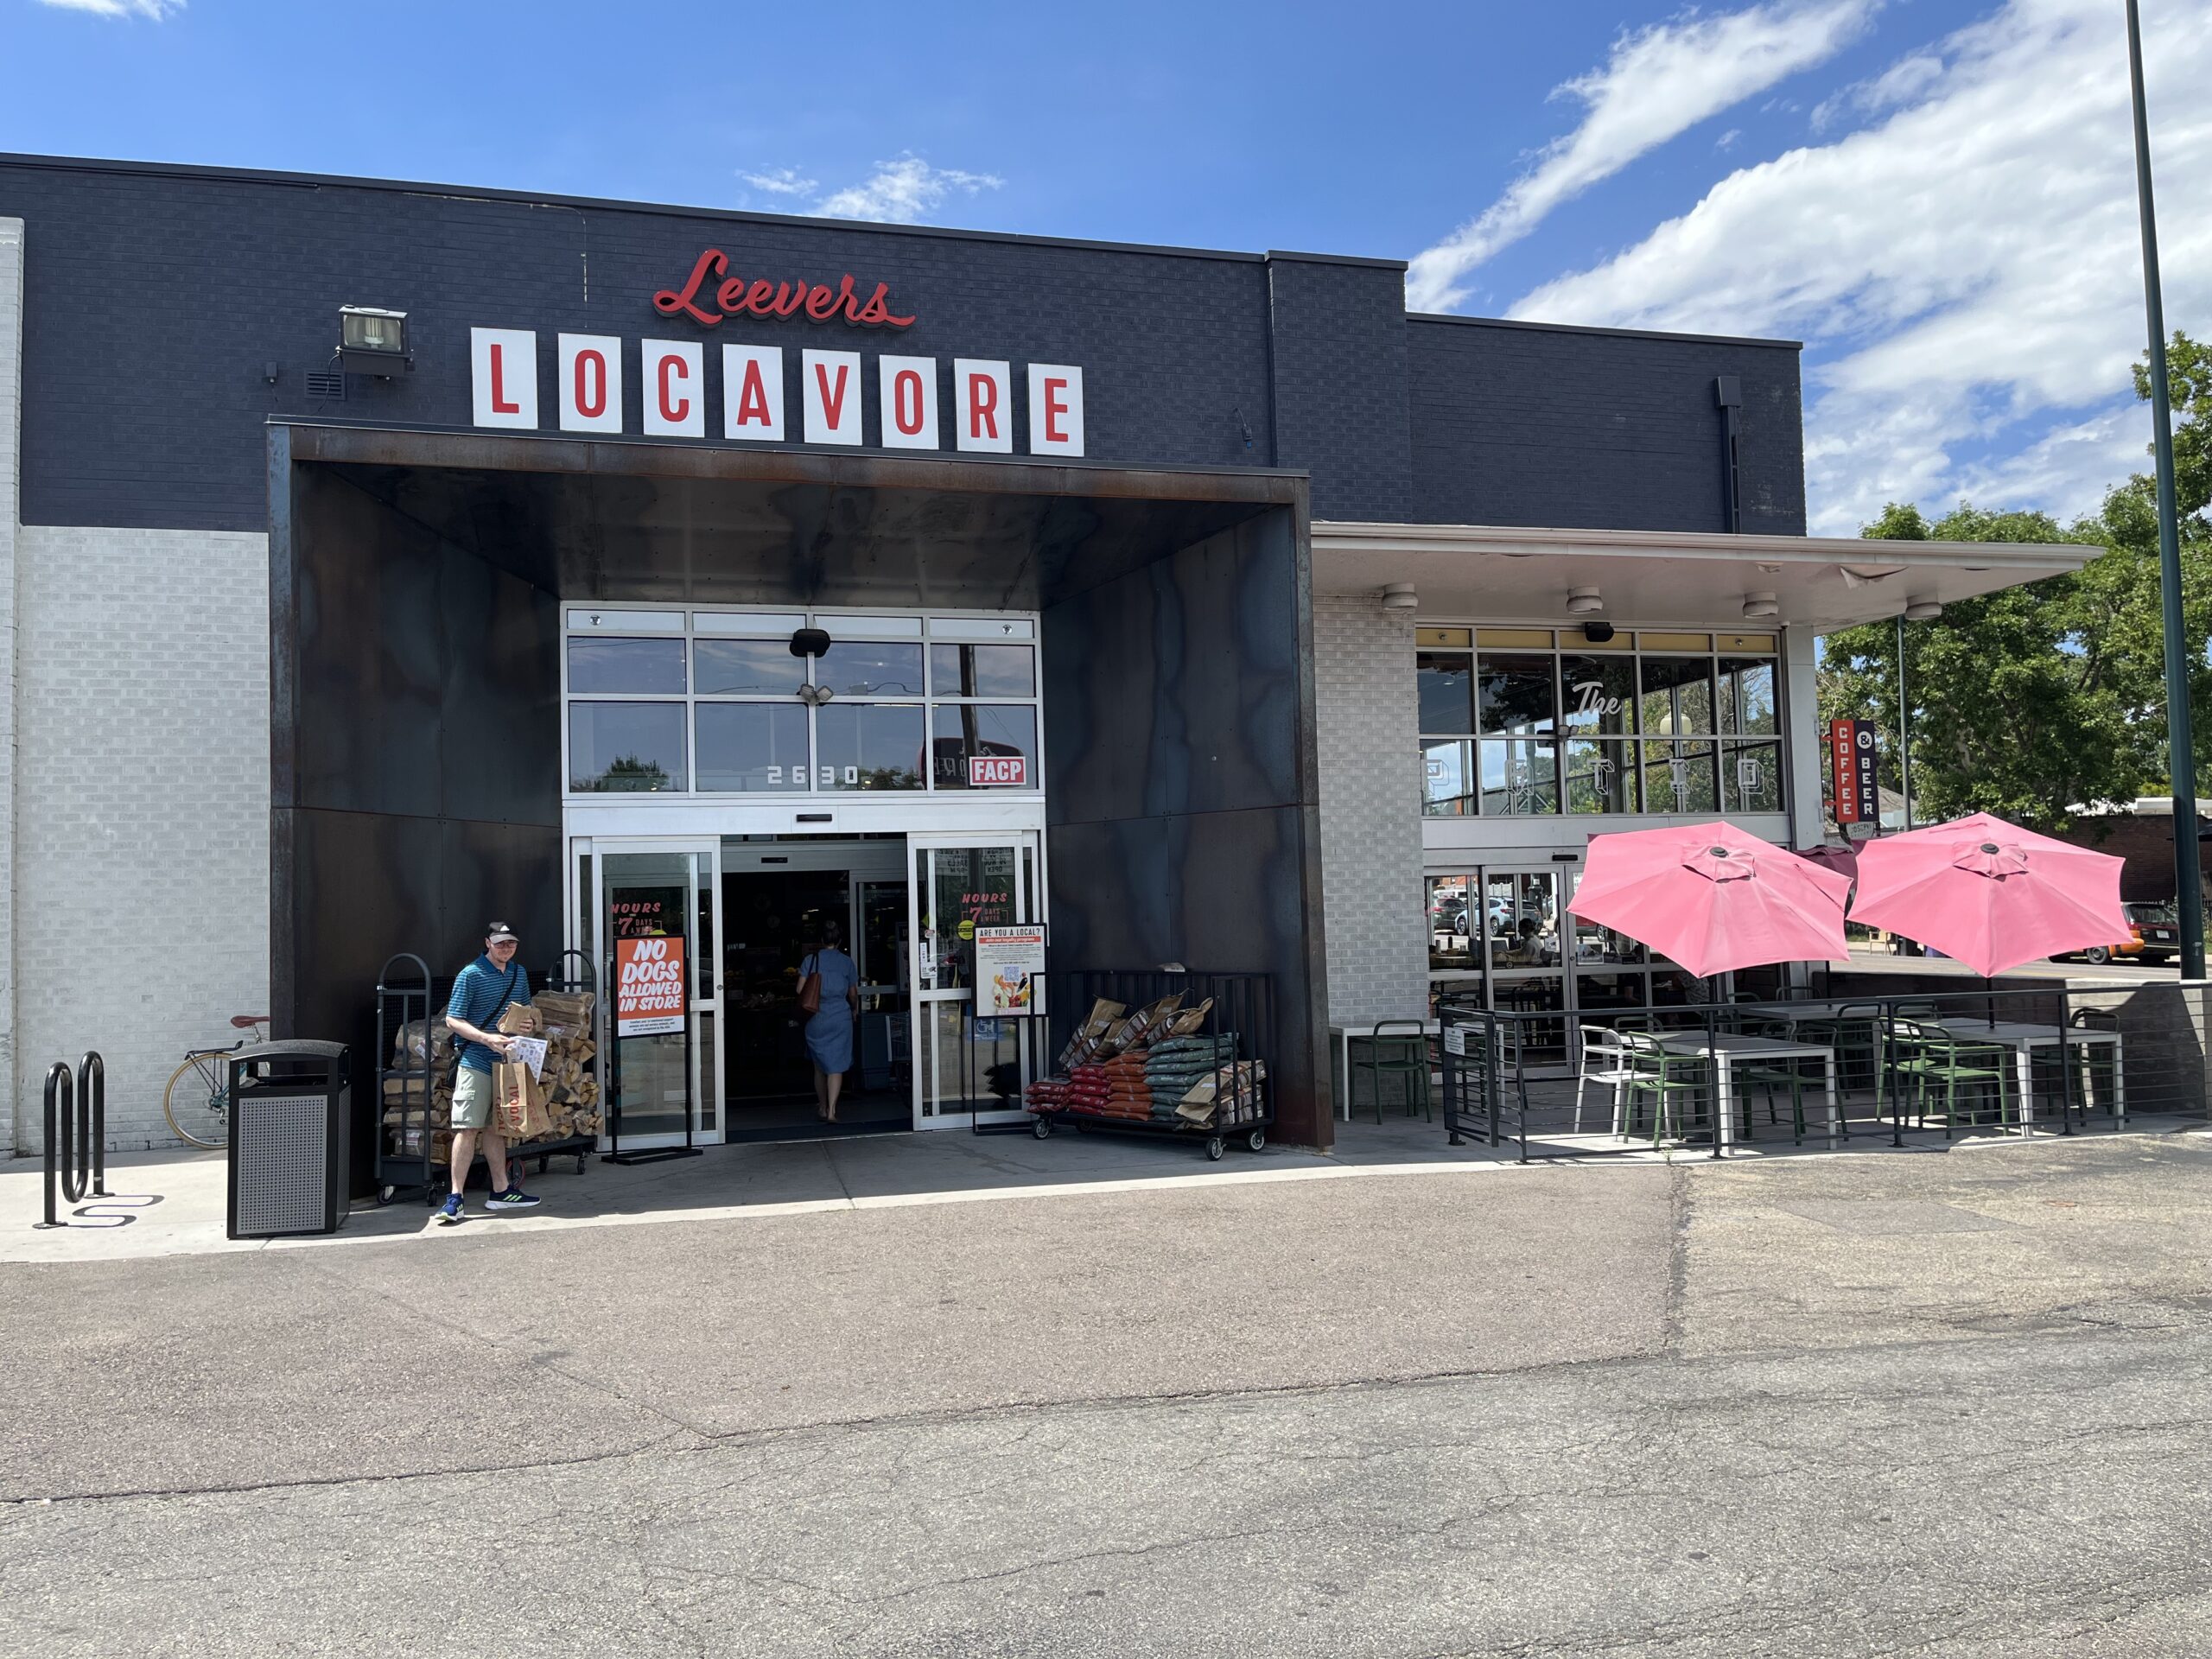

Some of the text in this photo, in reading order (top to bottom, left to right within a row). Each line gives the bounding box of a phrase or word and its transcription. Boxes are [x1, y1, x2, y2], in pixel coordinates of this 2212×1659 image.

[653, 248, 916, 330] Leevers
[489, 343, 1069, 442] LOCAVORE
[1572, 681, 1622, 717] The
[766, 766, 858, 785] 2630
[974, 761, 1021, 781] FACP
[1838, 727, 1853, 815] COFFEE
[1860, 757, 1874, 815] BEER
[610, 902, 661, 914] HOURS
[962, 893, 1008, 904] HOURS
[969, 906, 982, 923] 7
[618, 917, 633, 935] 7
[980, 929, 992, 938] ARE
[995, 928, 1007, 937] YOU
[1009, 928, 1014, 937] A
[1016, 927, 1040, 937] LOCAL?
[633, 939, 667, 961] NO
[621, 961, 680, 984] DOGS
[619, 982, 683, 998] ALLOWED
[619, 995, 681, 1013] IN STORE
